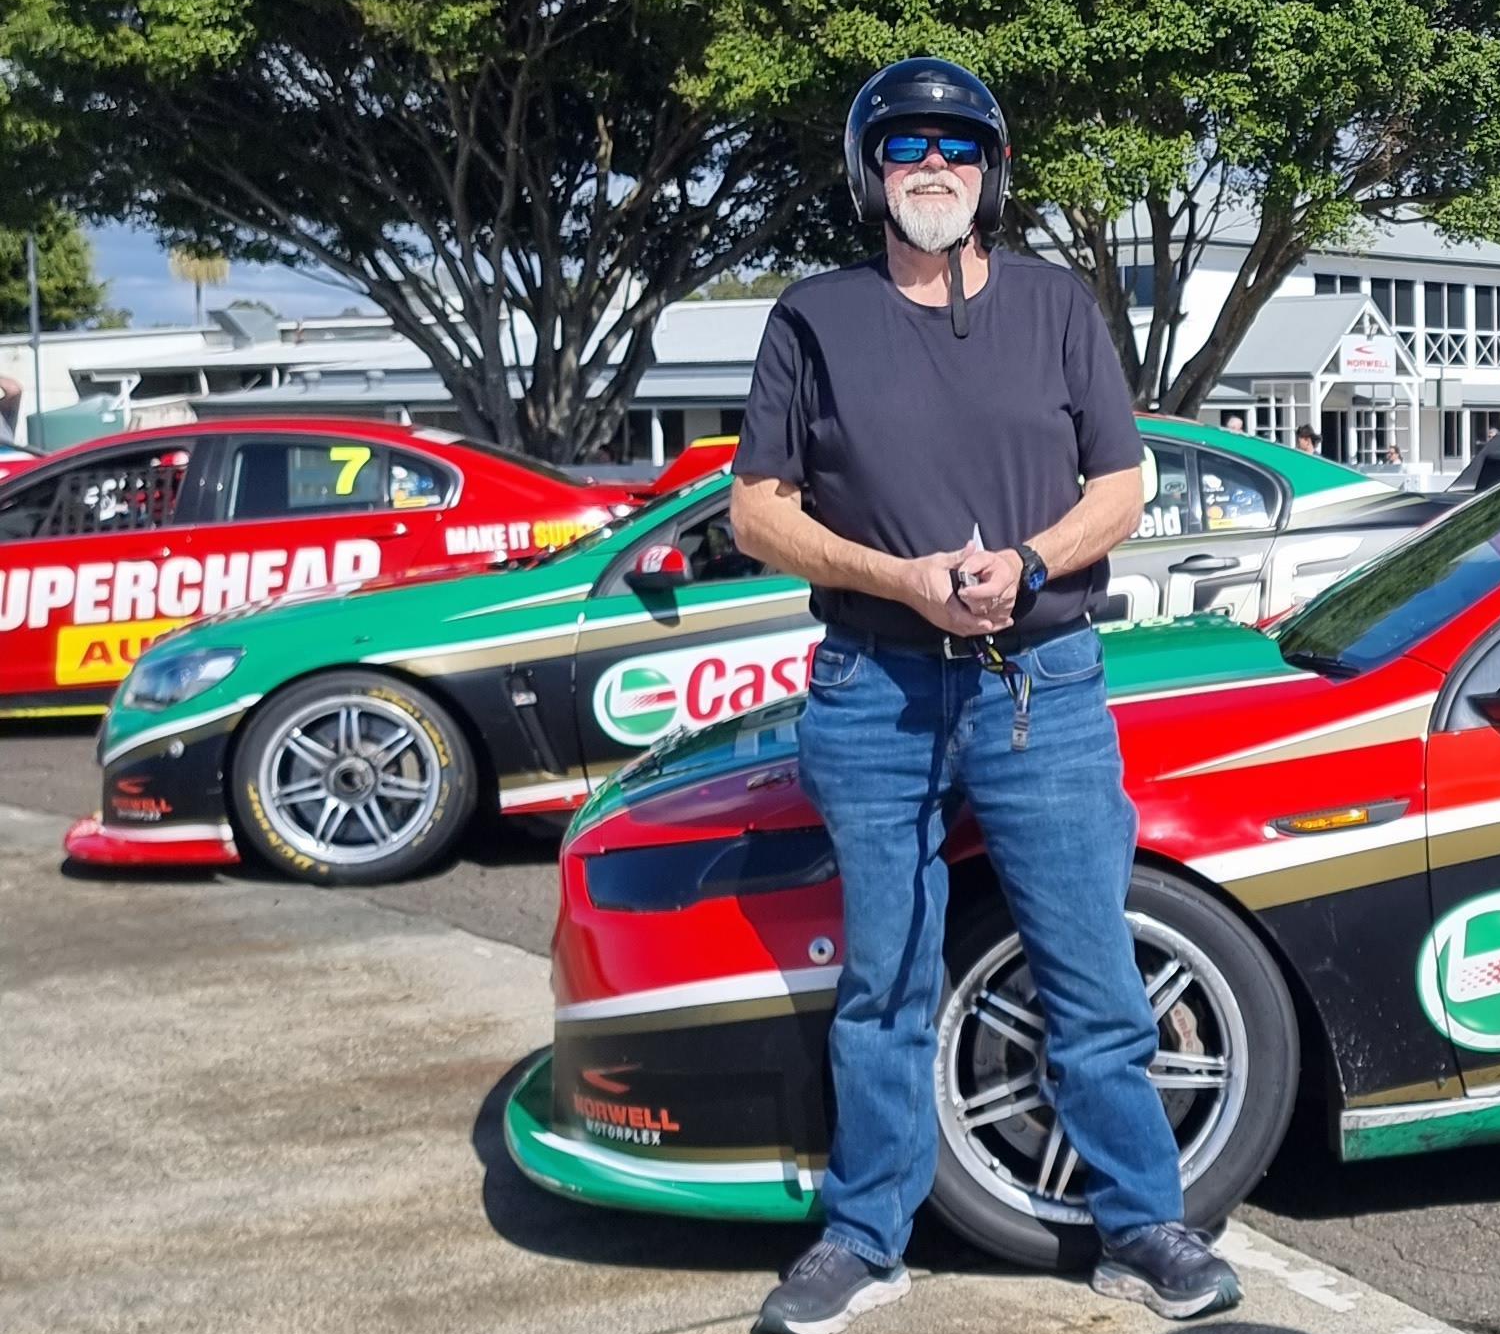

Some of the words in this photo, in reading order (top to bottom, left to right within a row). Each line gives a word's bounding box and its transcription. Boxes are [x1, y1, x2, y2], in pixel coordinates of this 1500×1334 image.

[329, 447, 371, 495] 7
[445, 524, 507, 555] MAKE
[508, 522, 531, 550] IT
[575, 1094, 680, 1131] NORWELL
[586, 1117, 661, 1147] MOTORPLEX
